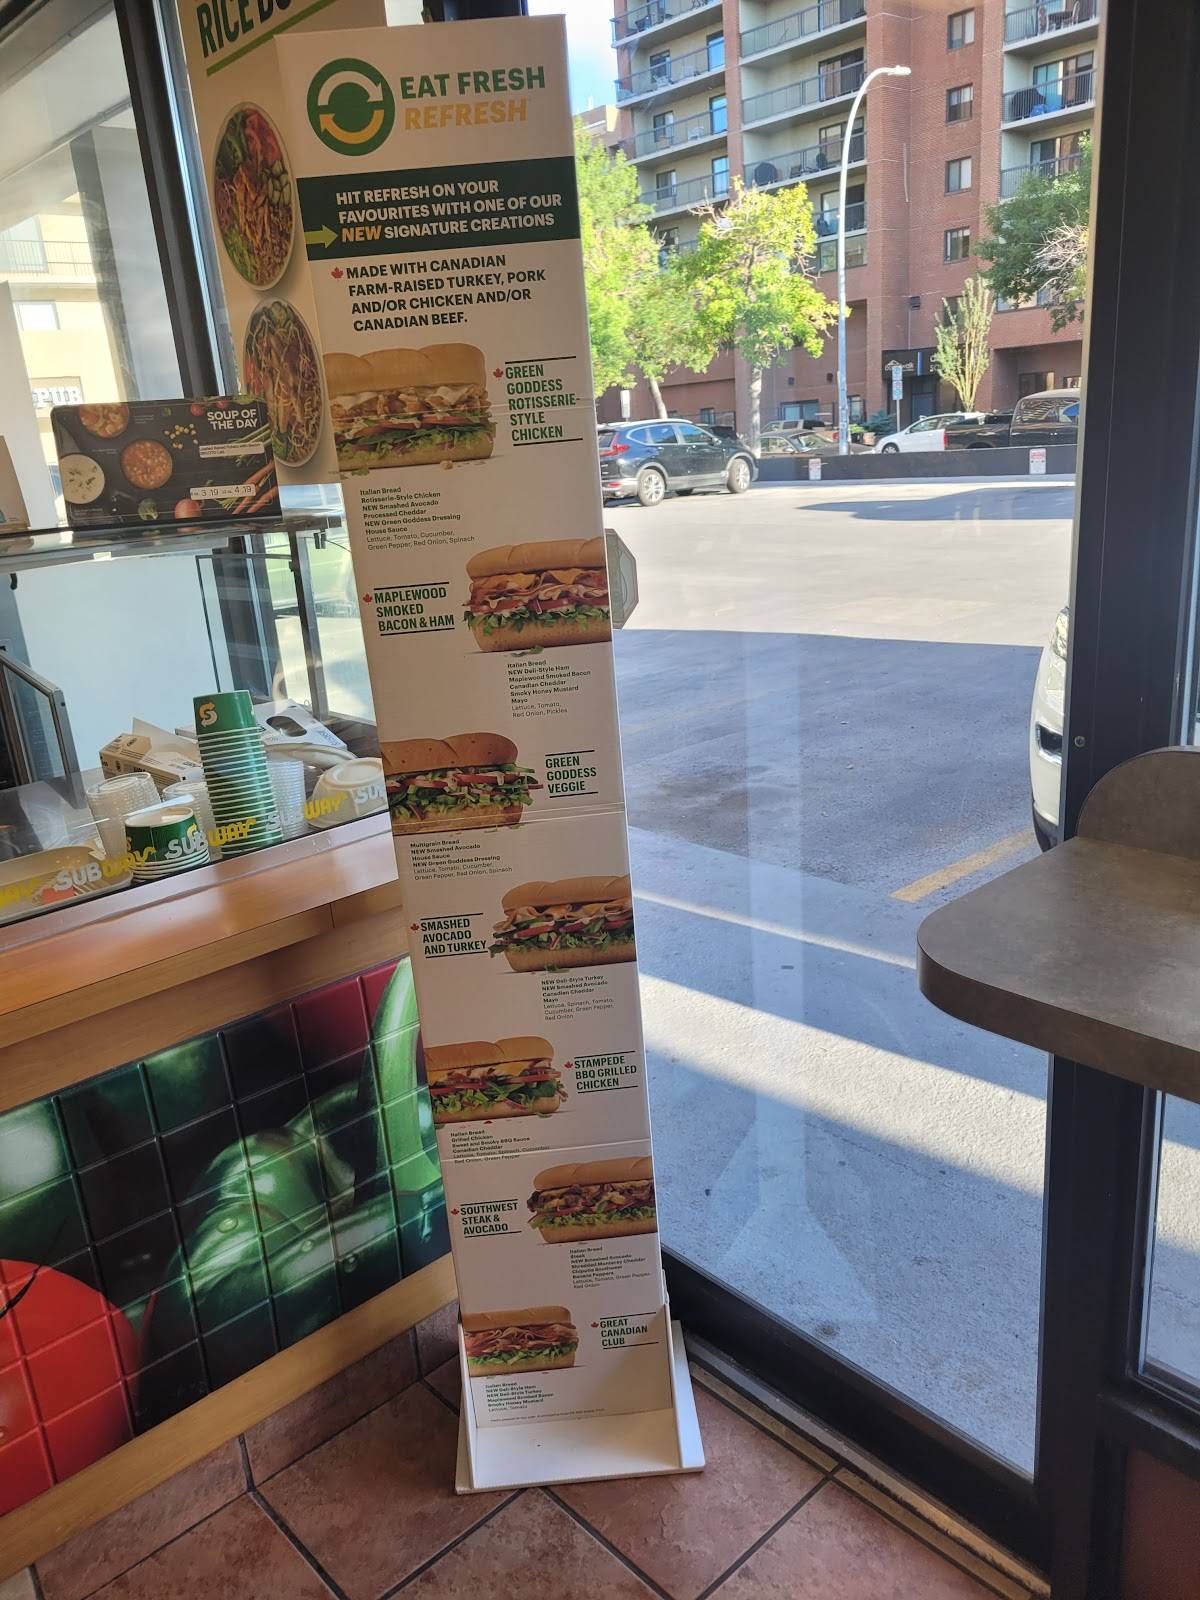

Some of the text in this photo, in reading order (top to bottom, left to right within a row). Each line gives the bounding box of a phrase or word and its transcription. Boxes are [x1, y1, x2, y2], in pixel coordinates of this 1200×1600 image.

[400, 66, 545, 99] EAT FRESH
[405, 97, 527, 130] REFRESH
[336, 180, 499, 205] HIT REFRESH ON YOUR
[338, 193, 562, 224] FAVOURITES WITH ONE OF OUR
[341, 213, 555, 242] NEW SIGNATURE CREATIONS
[347, 255, 506, 279] MADE WITH CANADIAN
[348, 269, 546, 297] FARM-RAISED TURKEY, PORK
[352, 289, 532, 314] AND/OR CHICKEN AND/OR
[353, 312, 468, 332] CANADIAN BEEF.
[506, 364, 544, 379] GREEN
[507, 379, 563, 395] GODDESS
[509, 393, 580, 410] ROTISSERIE-
[207, 409, 256, 420] SOUP OF
[510, 412, 545, 426] STYLE
[210, 418, 257, 430] THE DAY
[512, 425, 563, 441] CHICKEN
[374, 587, 446, 604] MAPLEWOOD
[376, 604, 423, 618] SMOKED
[378, 615, 455, 632] BACON & HAM
[545, 756, 580, 768] GREEN
[547, 767, 596, 781] GODDESS
[548, 781, 585, 793] VEGGIE
[421, 919, 470, 931] SMASHED
[423, 930, 472, 943] AVOCADO
[425, 940, 486, 955] AND TURKEY
[574, 1056, 625, 1069] STAMPEDE
[576, 1065, 637, 1079] BBQ GRILLED
[577, 1078, 619, 1090] CHICKEN
[461, 1203, 518, 1215] SOUTHWEST
[462, 1214, 500, 1225] STEAK &
[464, 1223, 508, 1235] AVOCADO
[600, 1318, 628, 1328] GREAT
[601, 1325, 647, 1337] CANADIAN
[602, 1338, 625, 1346] CLUB
